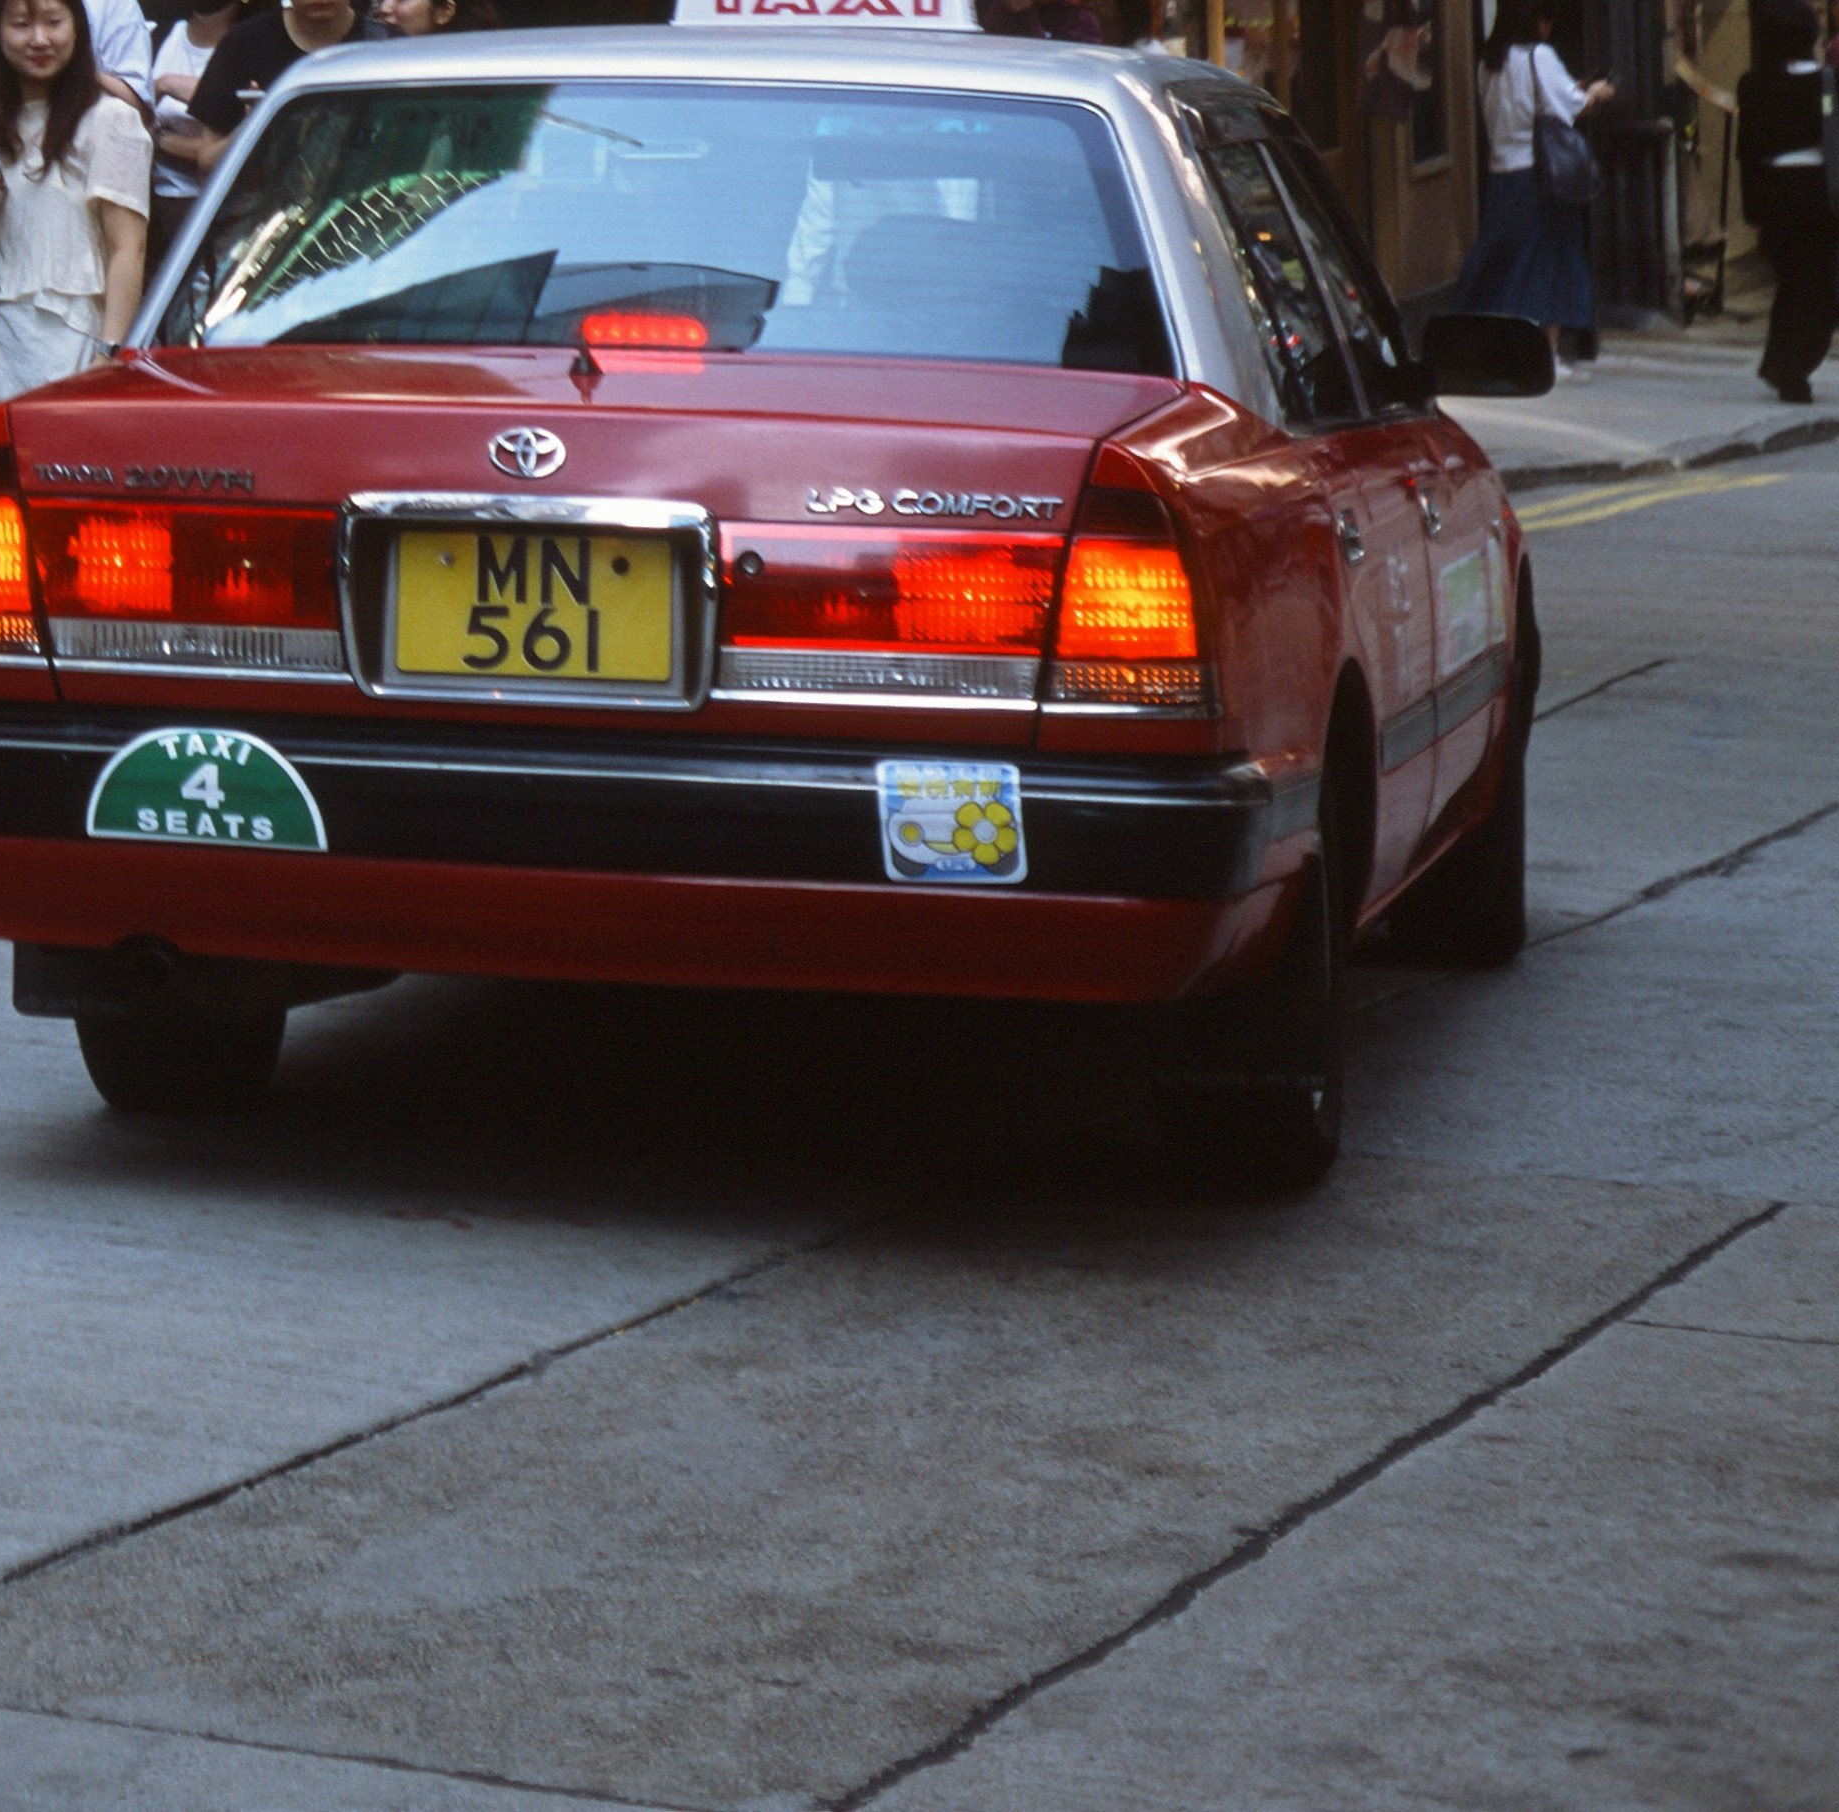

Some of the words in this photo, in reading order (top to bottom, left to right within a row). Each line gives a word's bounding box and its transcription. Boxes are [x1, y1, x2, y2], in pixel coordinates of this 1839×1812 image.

[806, 486, 885, 516] LPG
[891, 488, 1064, 520] COMFORT
[474, 534, 591, 608] MN
[461, 606, 601, 676] 561
[157, 733, 252, 767] TAXI
[180, 762, 226, 810] 4
[137, 807, 275, 841] SEATS
